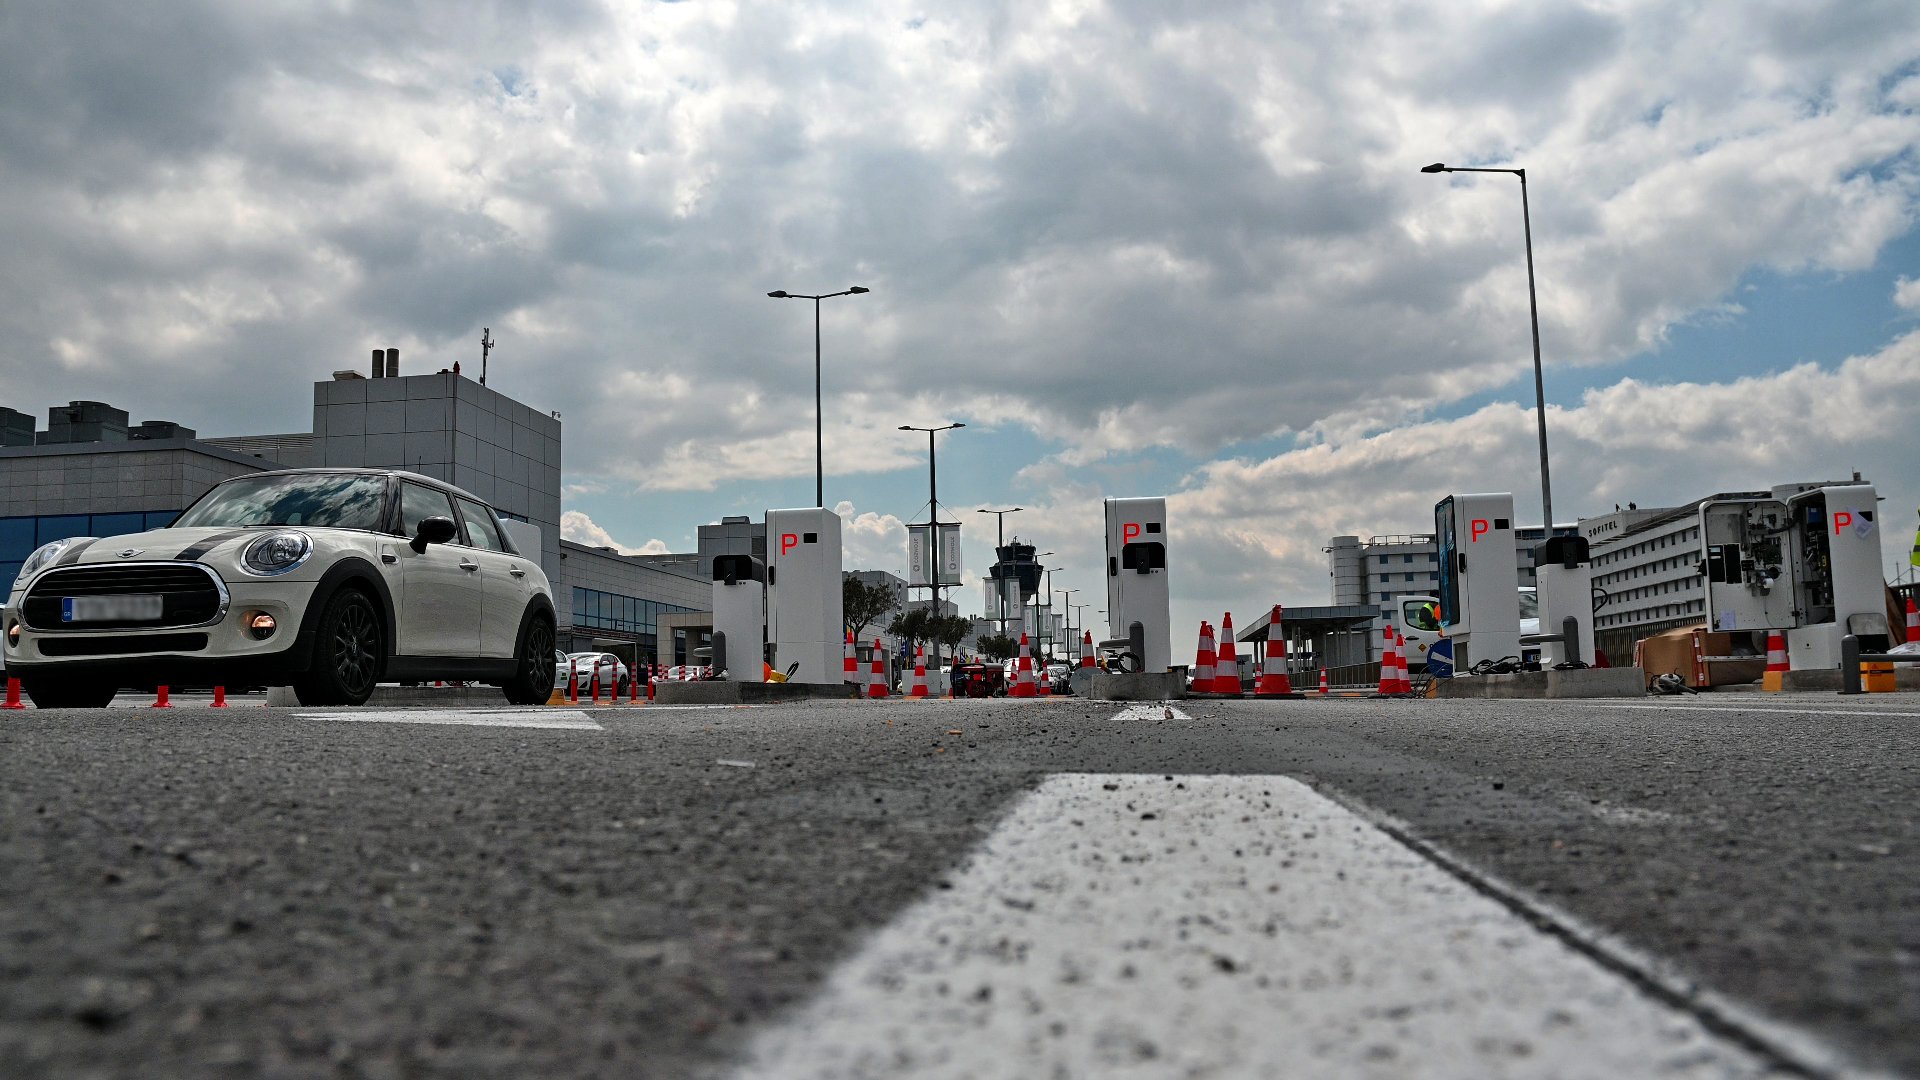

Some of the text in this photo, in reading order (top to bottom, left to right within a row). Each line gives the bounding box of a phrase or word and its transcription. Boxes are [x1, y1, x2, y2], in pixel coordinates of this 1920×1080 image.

[1123, 523, 1141, 544] P
[1471, 519, 1489, 542] P
[1589, 520, 1617, 537] SOFITEL
[1834, 512, 1852, 535] P
[781, 533, 798, 555] P
